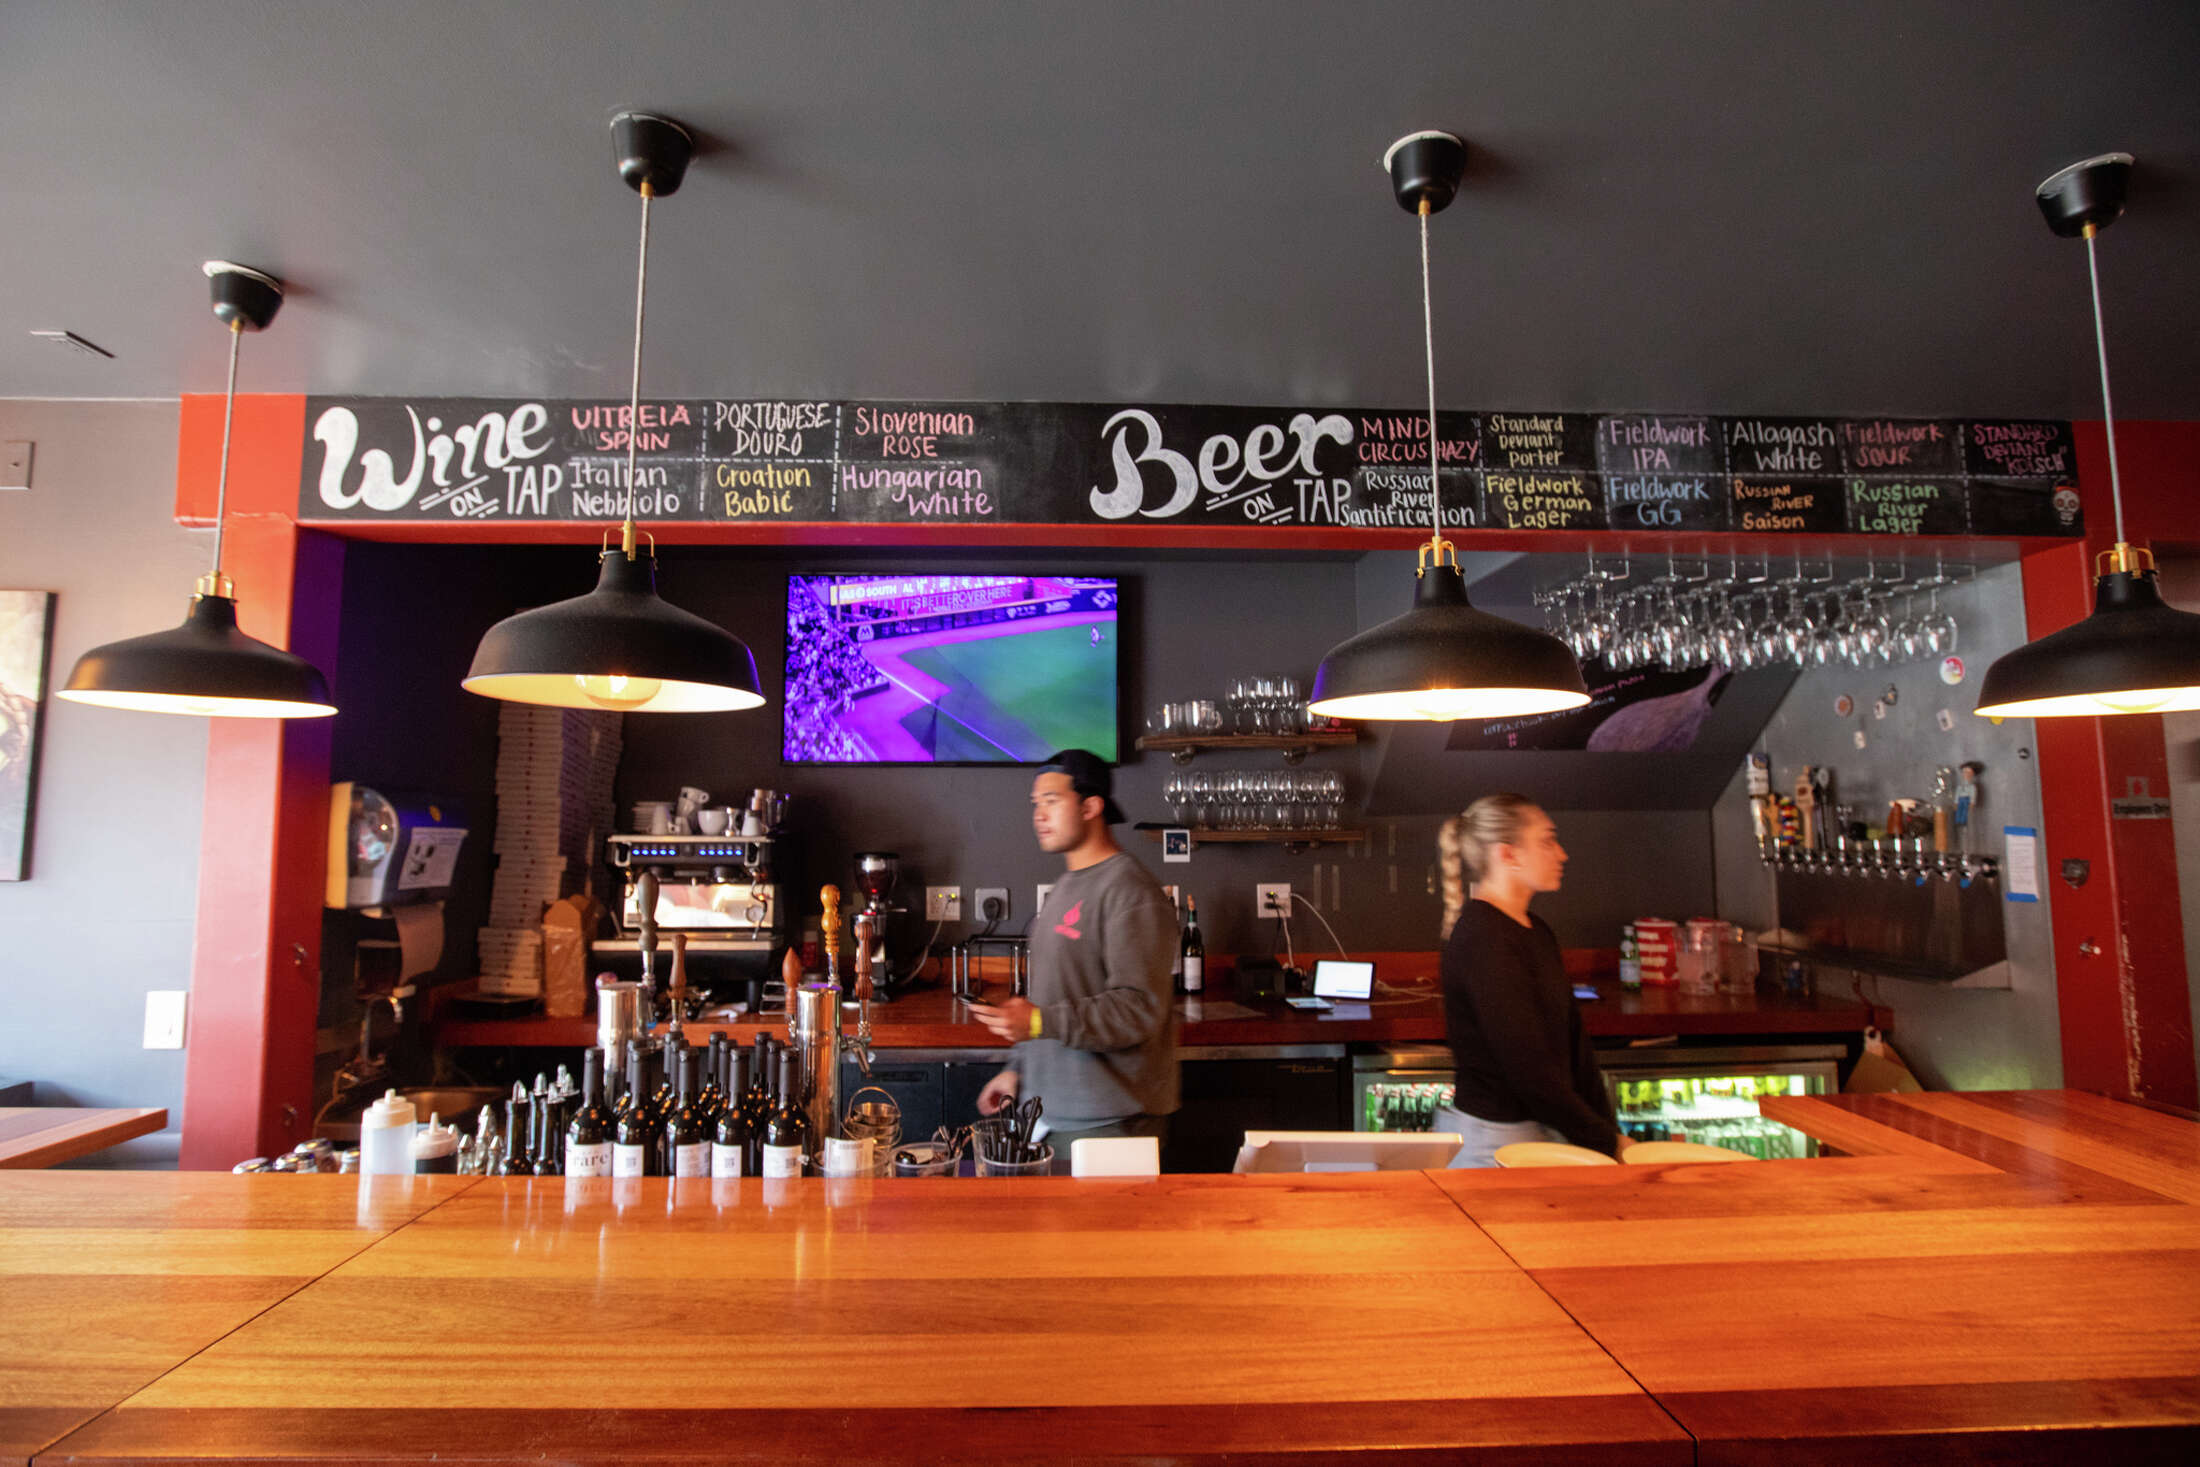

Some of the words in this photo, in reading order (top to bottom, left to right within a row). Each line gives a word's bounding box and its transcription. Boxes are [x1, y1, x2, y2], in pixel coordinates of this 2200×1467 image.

[714, 401, 831, 432] PORTUGUESE
[855, 406, 974, 436] Slovenian
[1361, 417, 1431, 441] MIND
[1489, 413, 1564, 433] Standard
[731, 428, 802, 456] DOURO
[882, 434, 938, 459] ROSE
[1610, 418, 1712, 448] Fieldwork
[1732, 421, 1836, 453] Allagash
[314, 403, 554, 511] Wine
[1089, 408, 1354, 520] Beer
[1358, 440, 1429, 463] CIRCUS
[1436, 440, 1480, 463] HAZY
[1632, 448, 1671, 471] IPA
[568, 460, 667, 488] Italian
[842, 464, 982, 503] Hungarian
[1486, 474, 1585, 495] Fieldwork
[450, 488, 484, 517] ON
[502, 465, 563, 515] TAP
[572, 487, 680, 516] Nebbiolo
[1293, 478, 1352, 523] TAP
[1609, 476, 1710, 502] Fieldwork
[1853, 479, 1940, 503] Russian
[1243, 492, 1275, 520] ON
[1340, 502, 1476, 527] Santificaion
[1503, 494, 1593, 513] German
[1508, 510, 1572, 530] Lager
[1742, 511, 1806, 531] Saison
[1859, 516, 1924, 534] Lager
